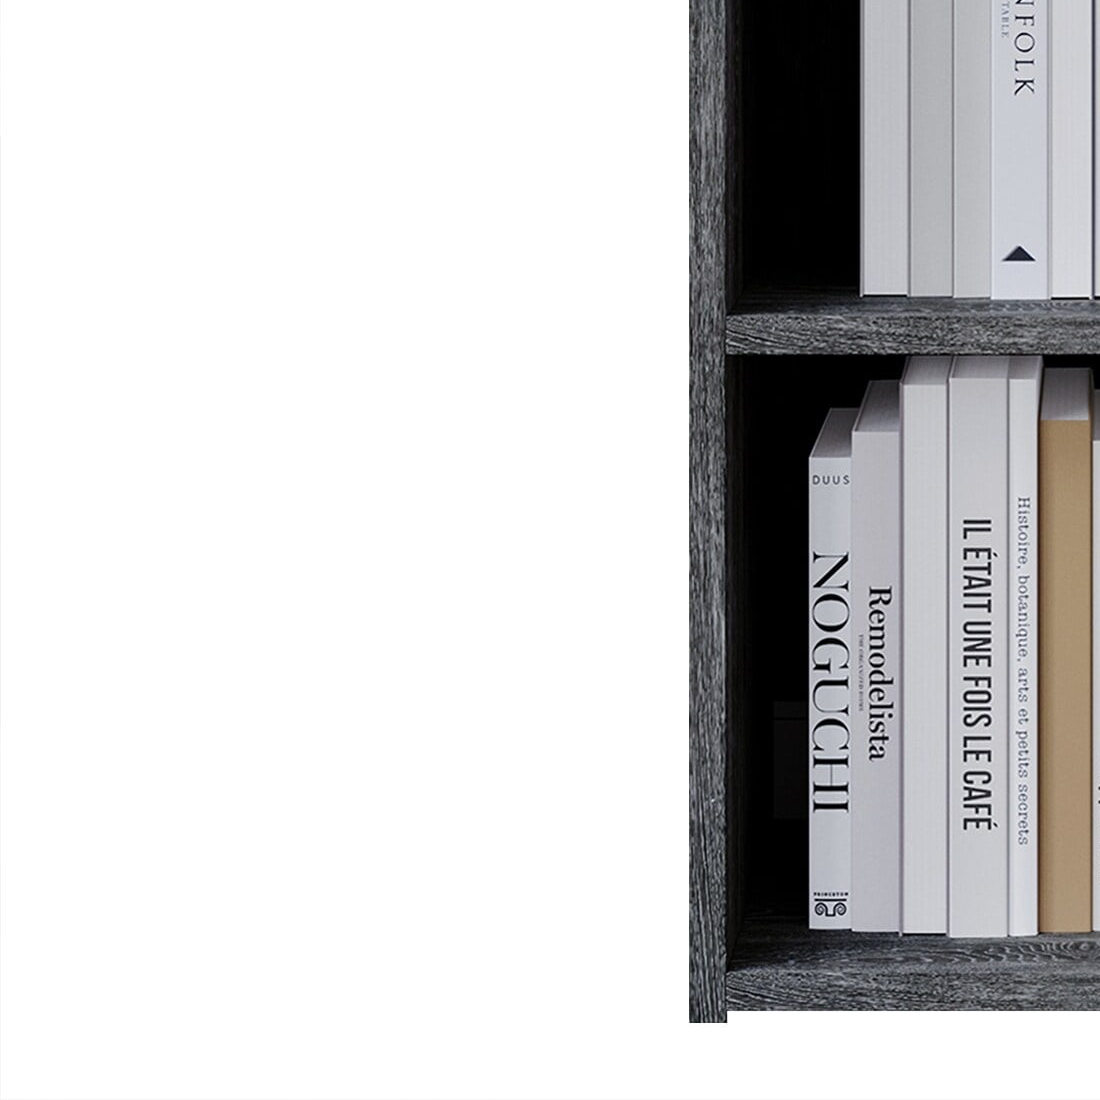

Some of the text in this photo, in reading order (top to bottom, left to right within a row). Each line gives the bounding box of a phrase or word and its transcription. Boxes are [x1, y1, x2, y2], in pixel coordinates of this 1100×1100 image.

[812, 475, 850, 485] DUUS
[813, 552, 849, 812] NOGUCHI
[869, 587, 893, 760] Remodelista
[963, 520, 997, 830] IL ÉTAIT UNE FOIS LE CAFÉ
[1016, 498, 1030, 845] Histoire, botanique, arts et petits secrets
